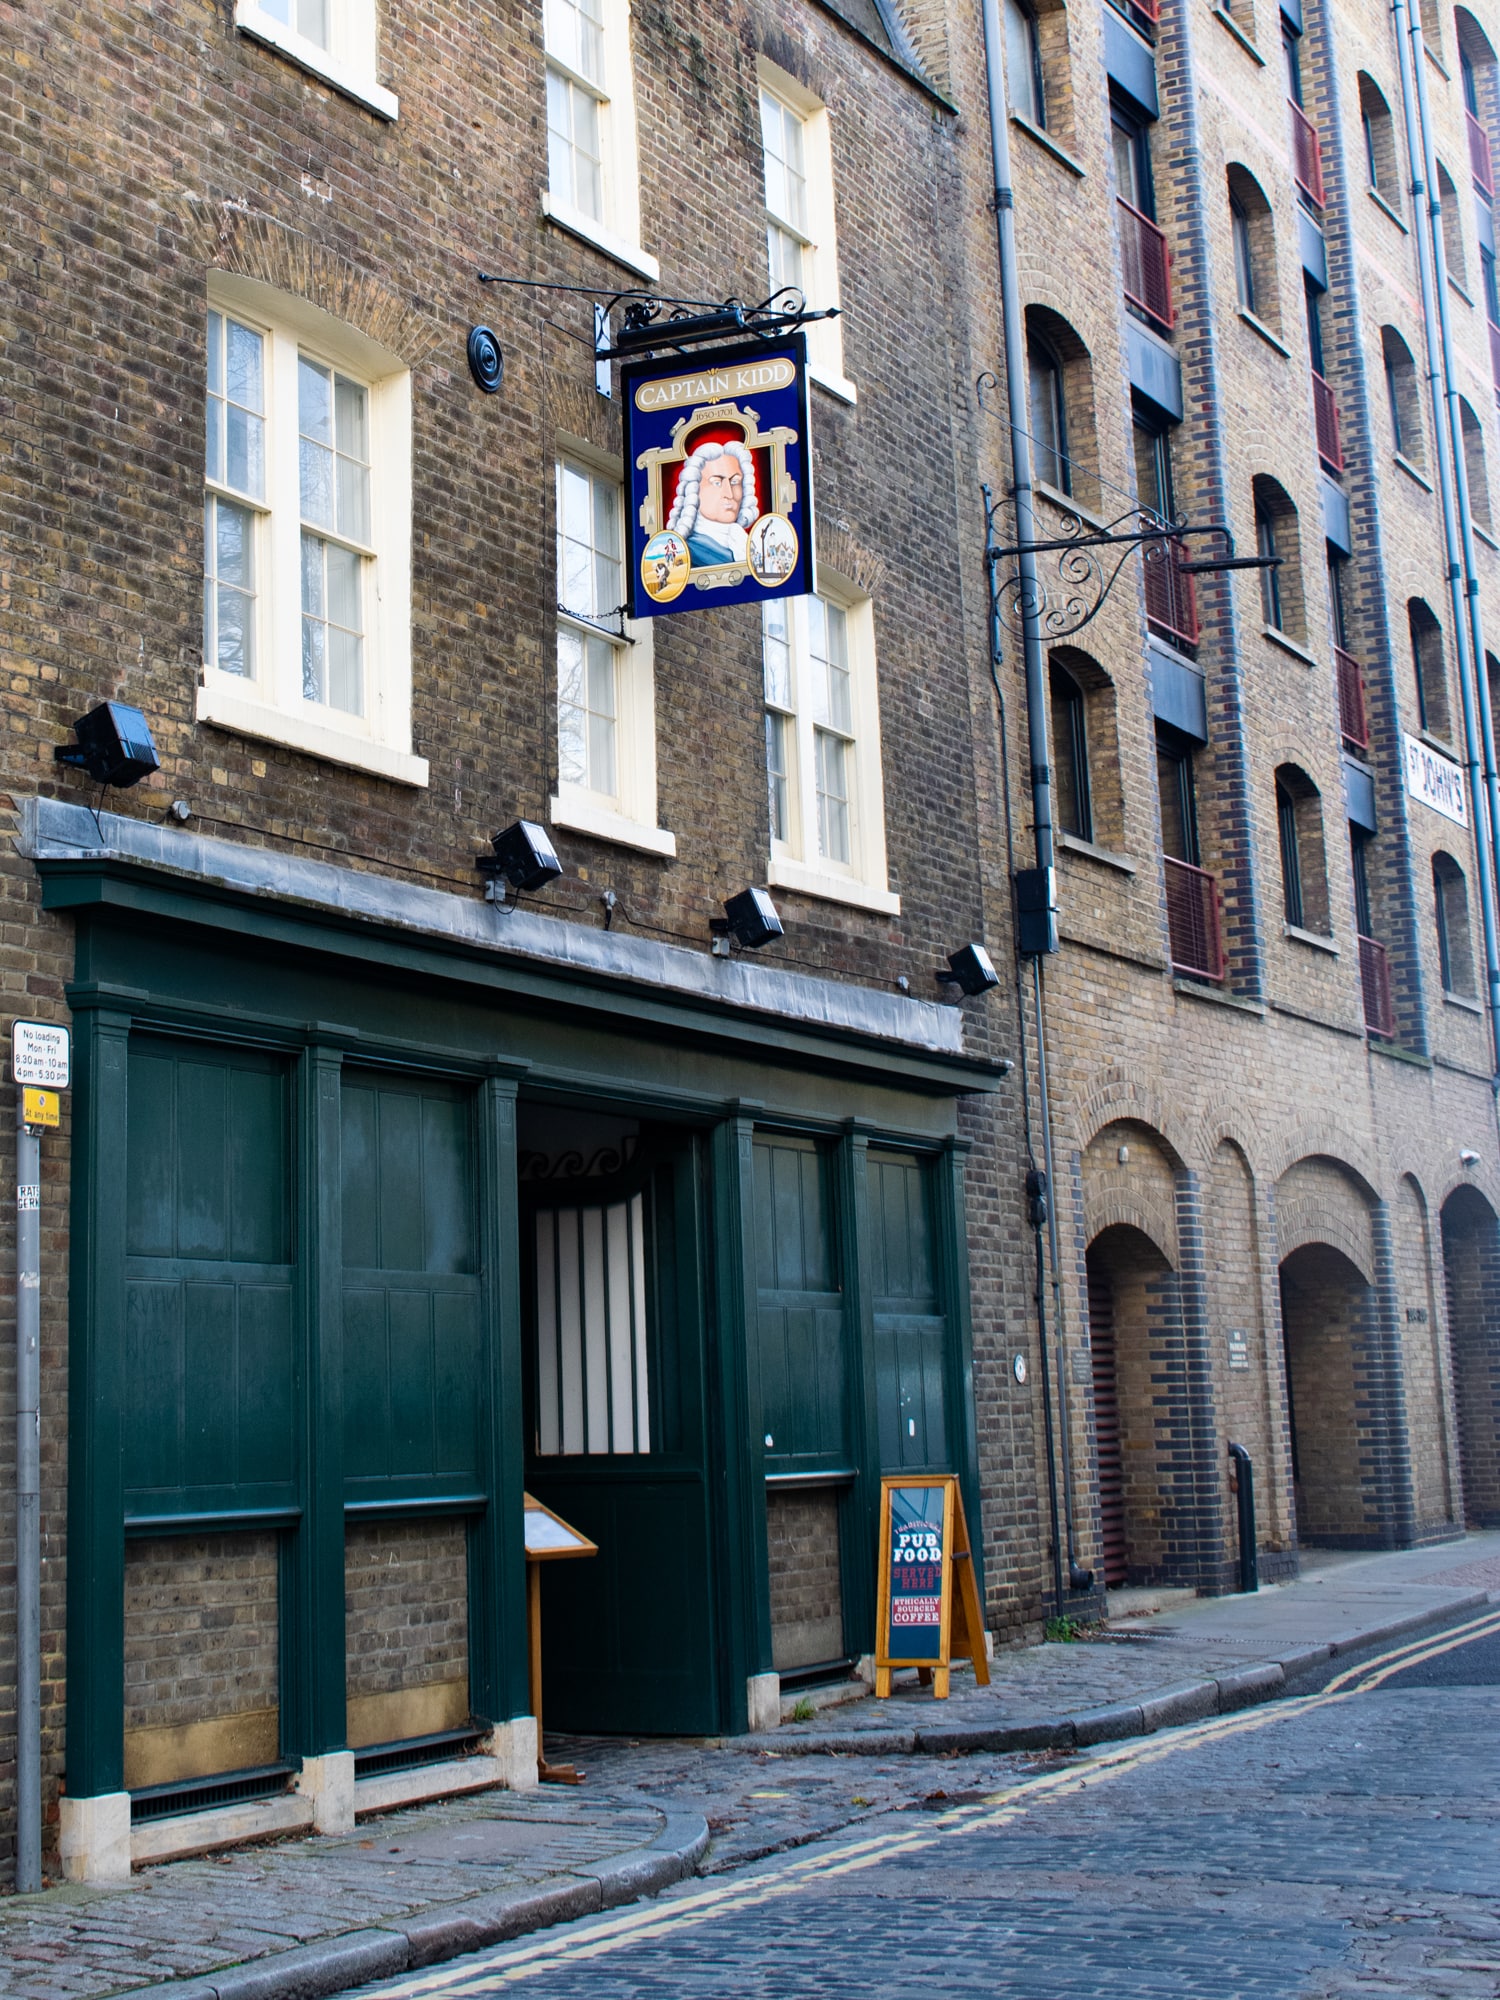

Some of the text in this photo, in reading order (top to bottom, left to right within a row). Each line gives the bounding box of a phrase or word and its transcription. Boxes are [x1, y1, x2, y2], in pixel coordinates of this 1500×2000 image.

[640, 363, 789, 405] CAPTAIN KIDD
[23, 1029, 60, 1044] No loading
[27, 1042, 42, 1053] Mon
[47, 1045, 57, 1055] Fri
[16, 1054, 32, 1065] 8.30
[33, 1058, 44, 1066] am
[48, 1058, 56, 1068] 10
[57, 1061, 67, 1069] am
[16, 1067, 22, 1076] 4
[23, 1070, 34, 1078] pm
[38, 1069, 55, 1080] 5.30
[56, 1072, 67, 1081] pm
[25, 1107, 58, 1122] At any time
[899, 1533, 938, 1548] PUB
[893, 1547, 942, 1562] FOOD
[893, 1566, 942, 1578] SERVED
[902, 1576, 934, 1588] HERE
[894, 1597, 939, 1605] ETHICALLY
[894, 1612, 939, 1623] COFFEE
